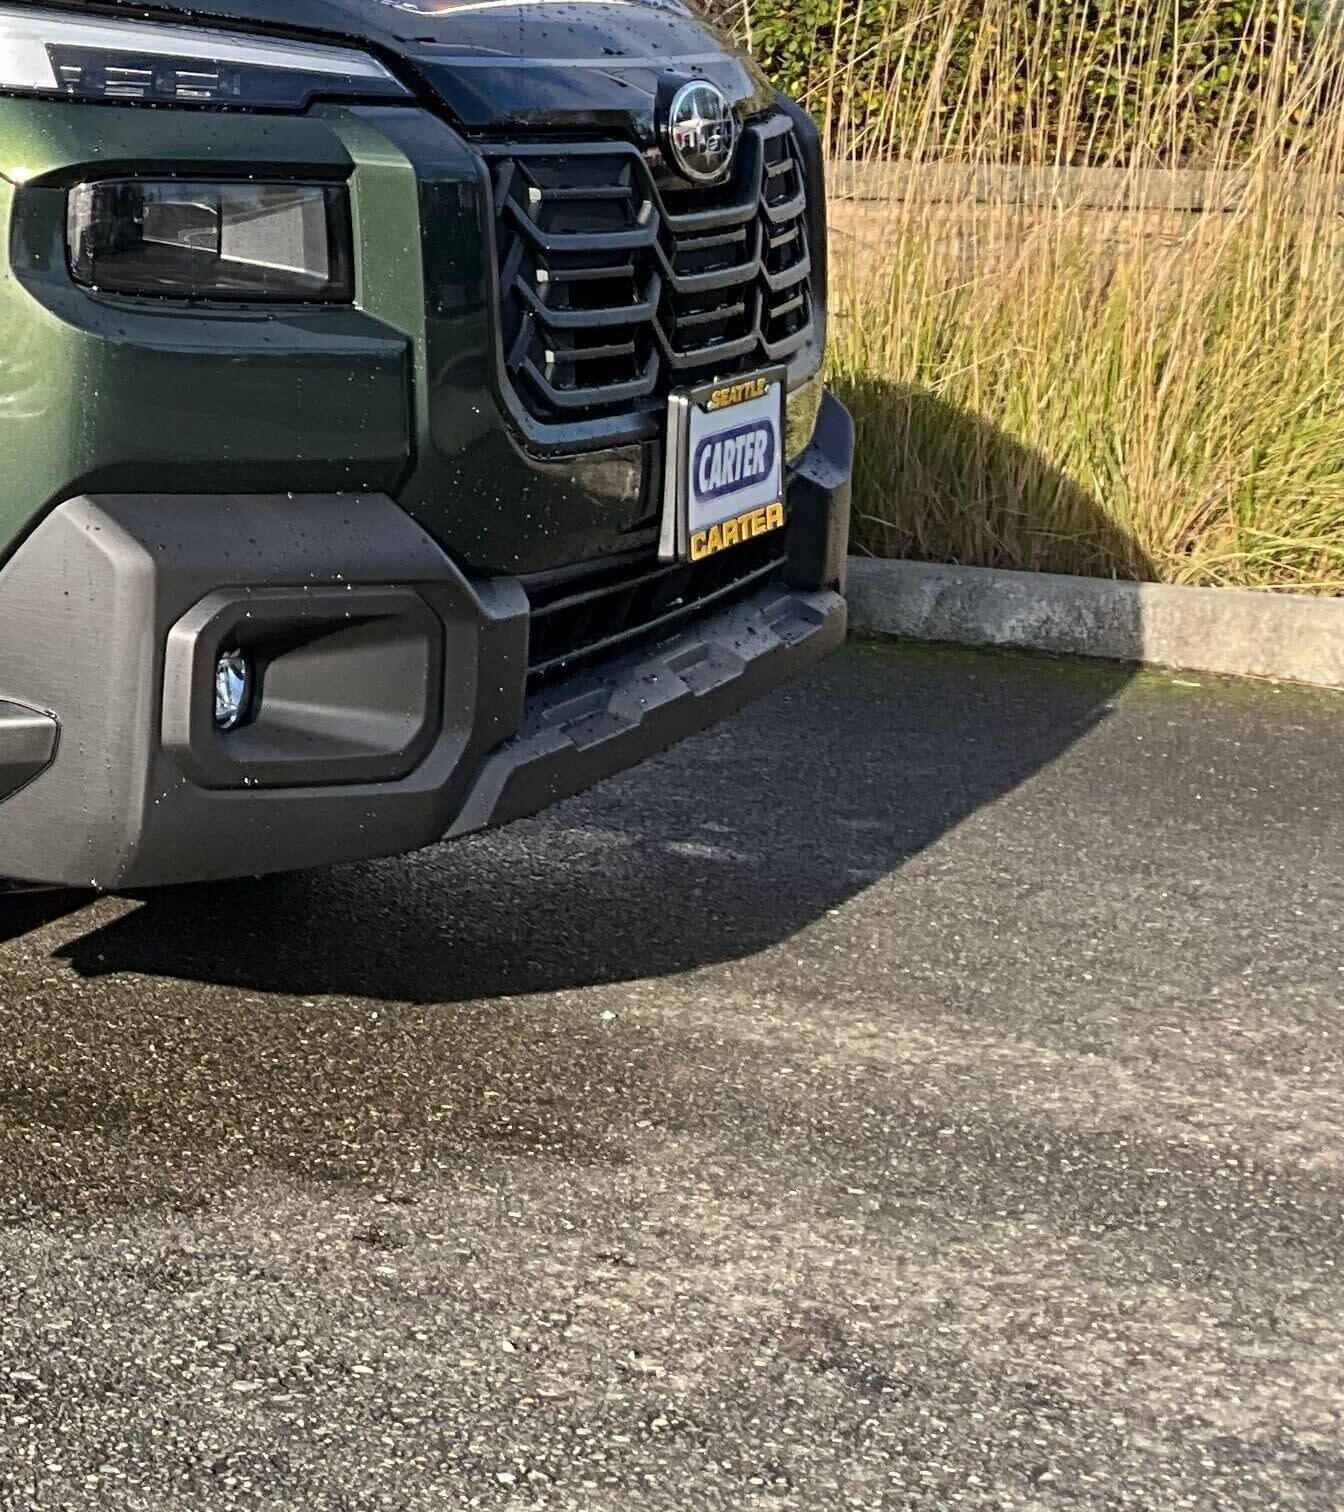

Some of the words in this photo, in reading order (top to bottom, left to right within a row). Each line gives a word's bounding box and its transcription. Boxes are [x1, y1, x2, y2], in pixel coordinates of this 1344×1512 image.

[712, 378, 766, 408] SEATTLE
[699, 429, 768, 493] CARTER
[691, 502, 784, 562] CARTER
